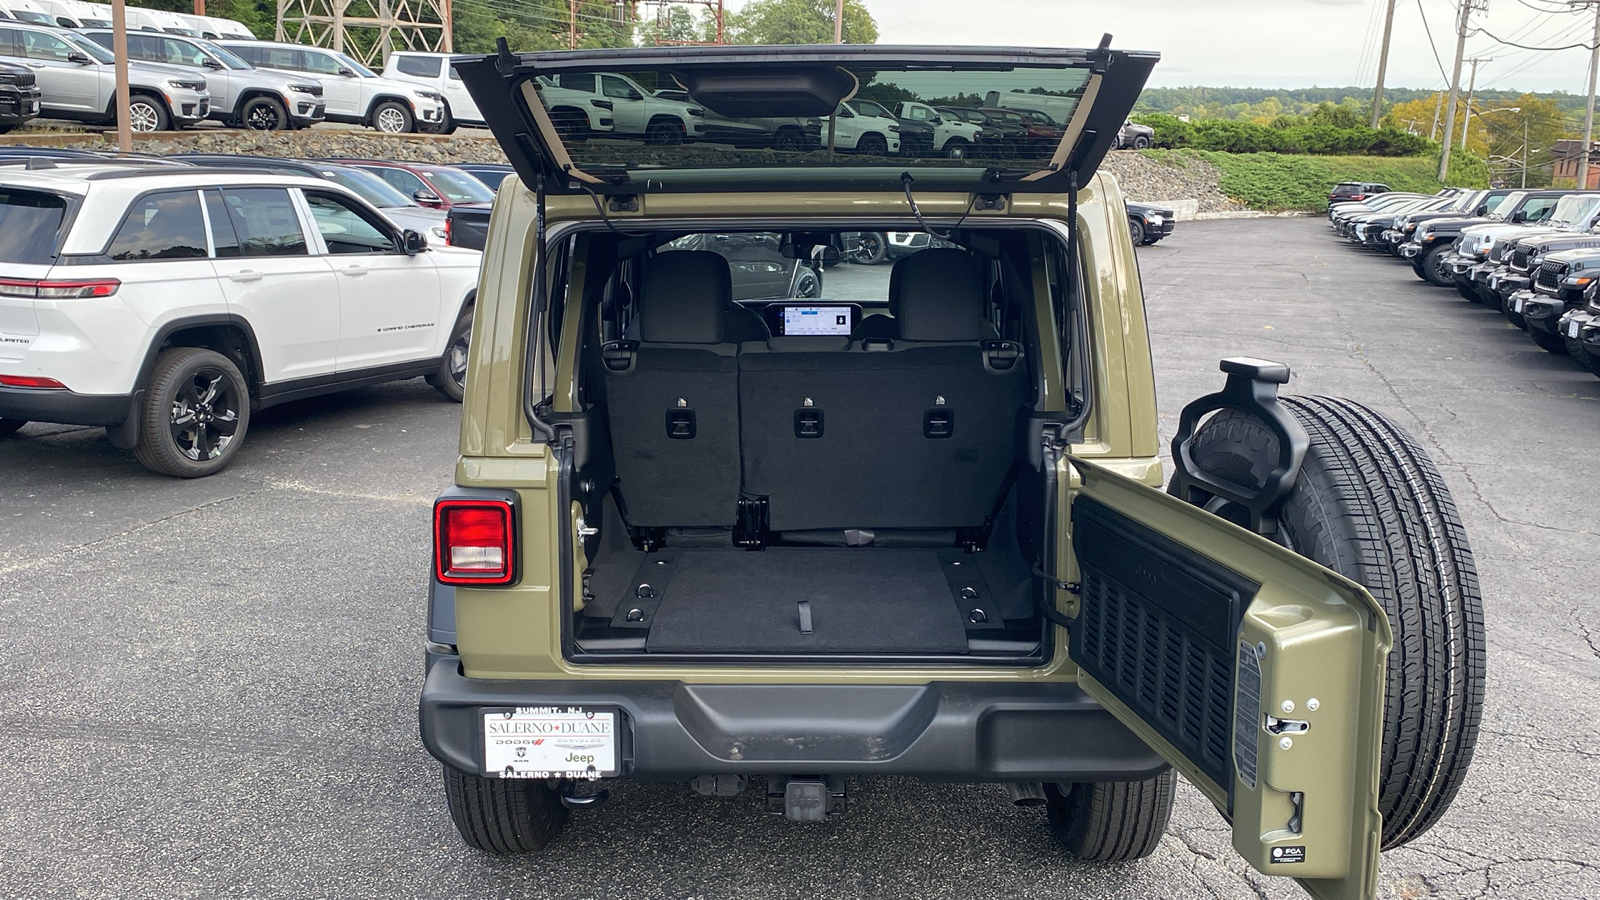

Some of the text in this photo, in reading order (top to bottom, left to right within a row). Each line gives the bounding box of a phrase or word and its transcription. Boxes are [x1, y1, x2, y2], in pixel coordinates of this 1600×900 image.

[404, 322, 434, 330] CHEROKEE
[489, 722, 610, 734] SALERNO DUANE
[565, 752, 595, 764] Jeep
[499, 771, 602, 779] SALERNO DUANE
